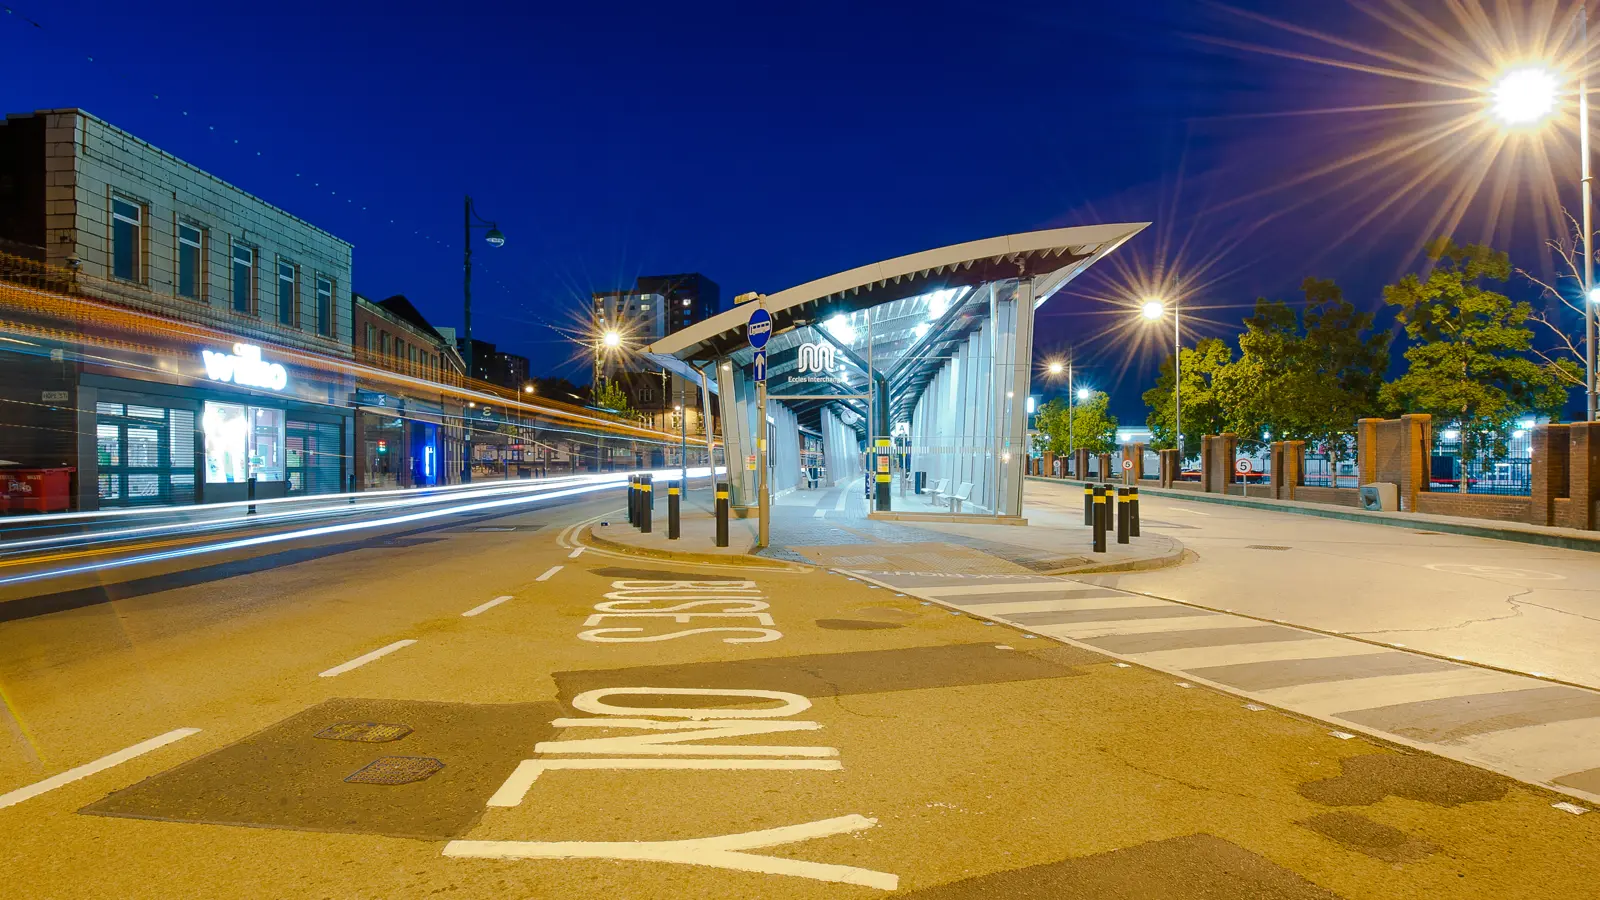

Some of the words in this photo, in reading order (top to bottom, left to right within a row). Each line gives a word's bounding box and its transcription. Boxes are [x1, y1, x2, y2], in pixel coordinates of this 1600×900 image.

[788, 375, 807, 383] Eccles
[1125, 460, 1131, 468] 5
[1240, 461, 1247, 471] 5
[576, 580, 783, 644] BUSES
[441, 686, 899, 891] ONLY
